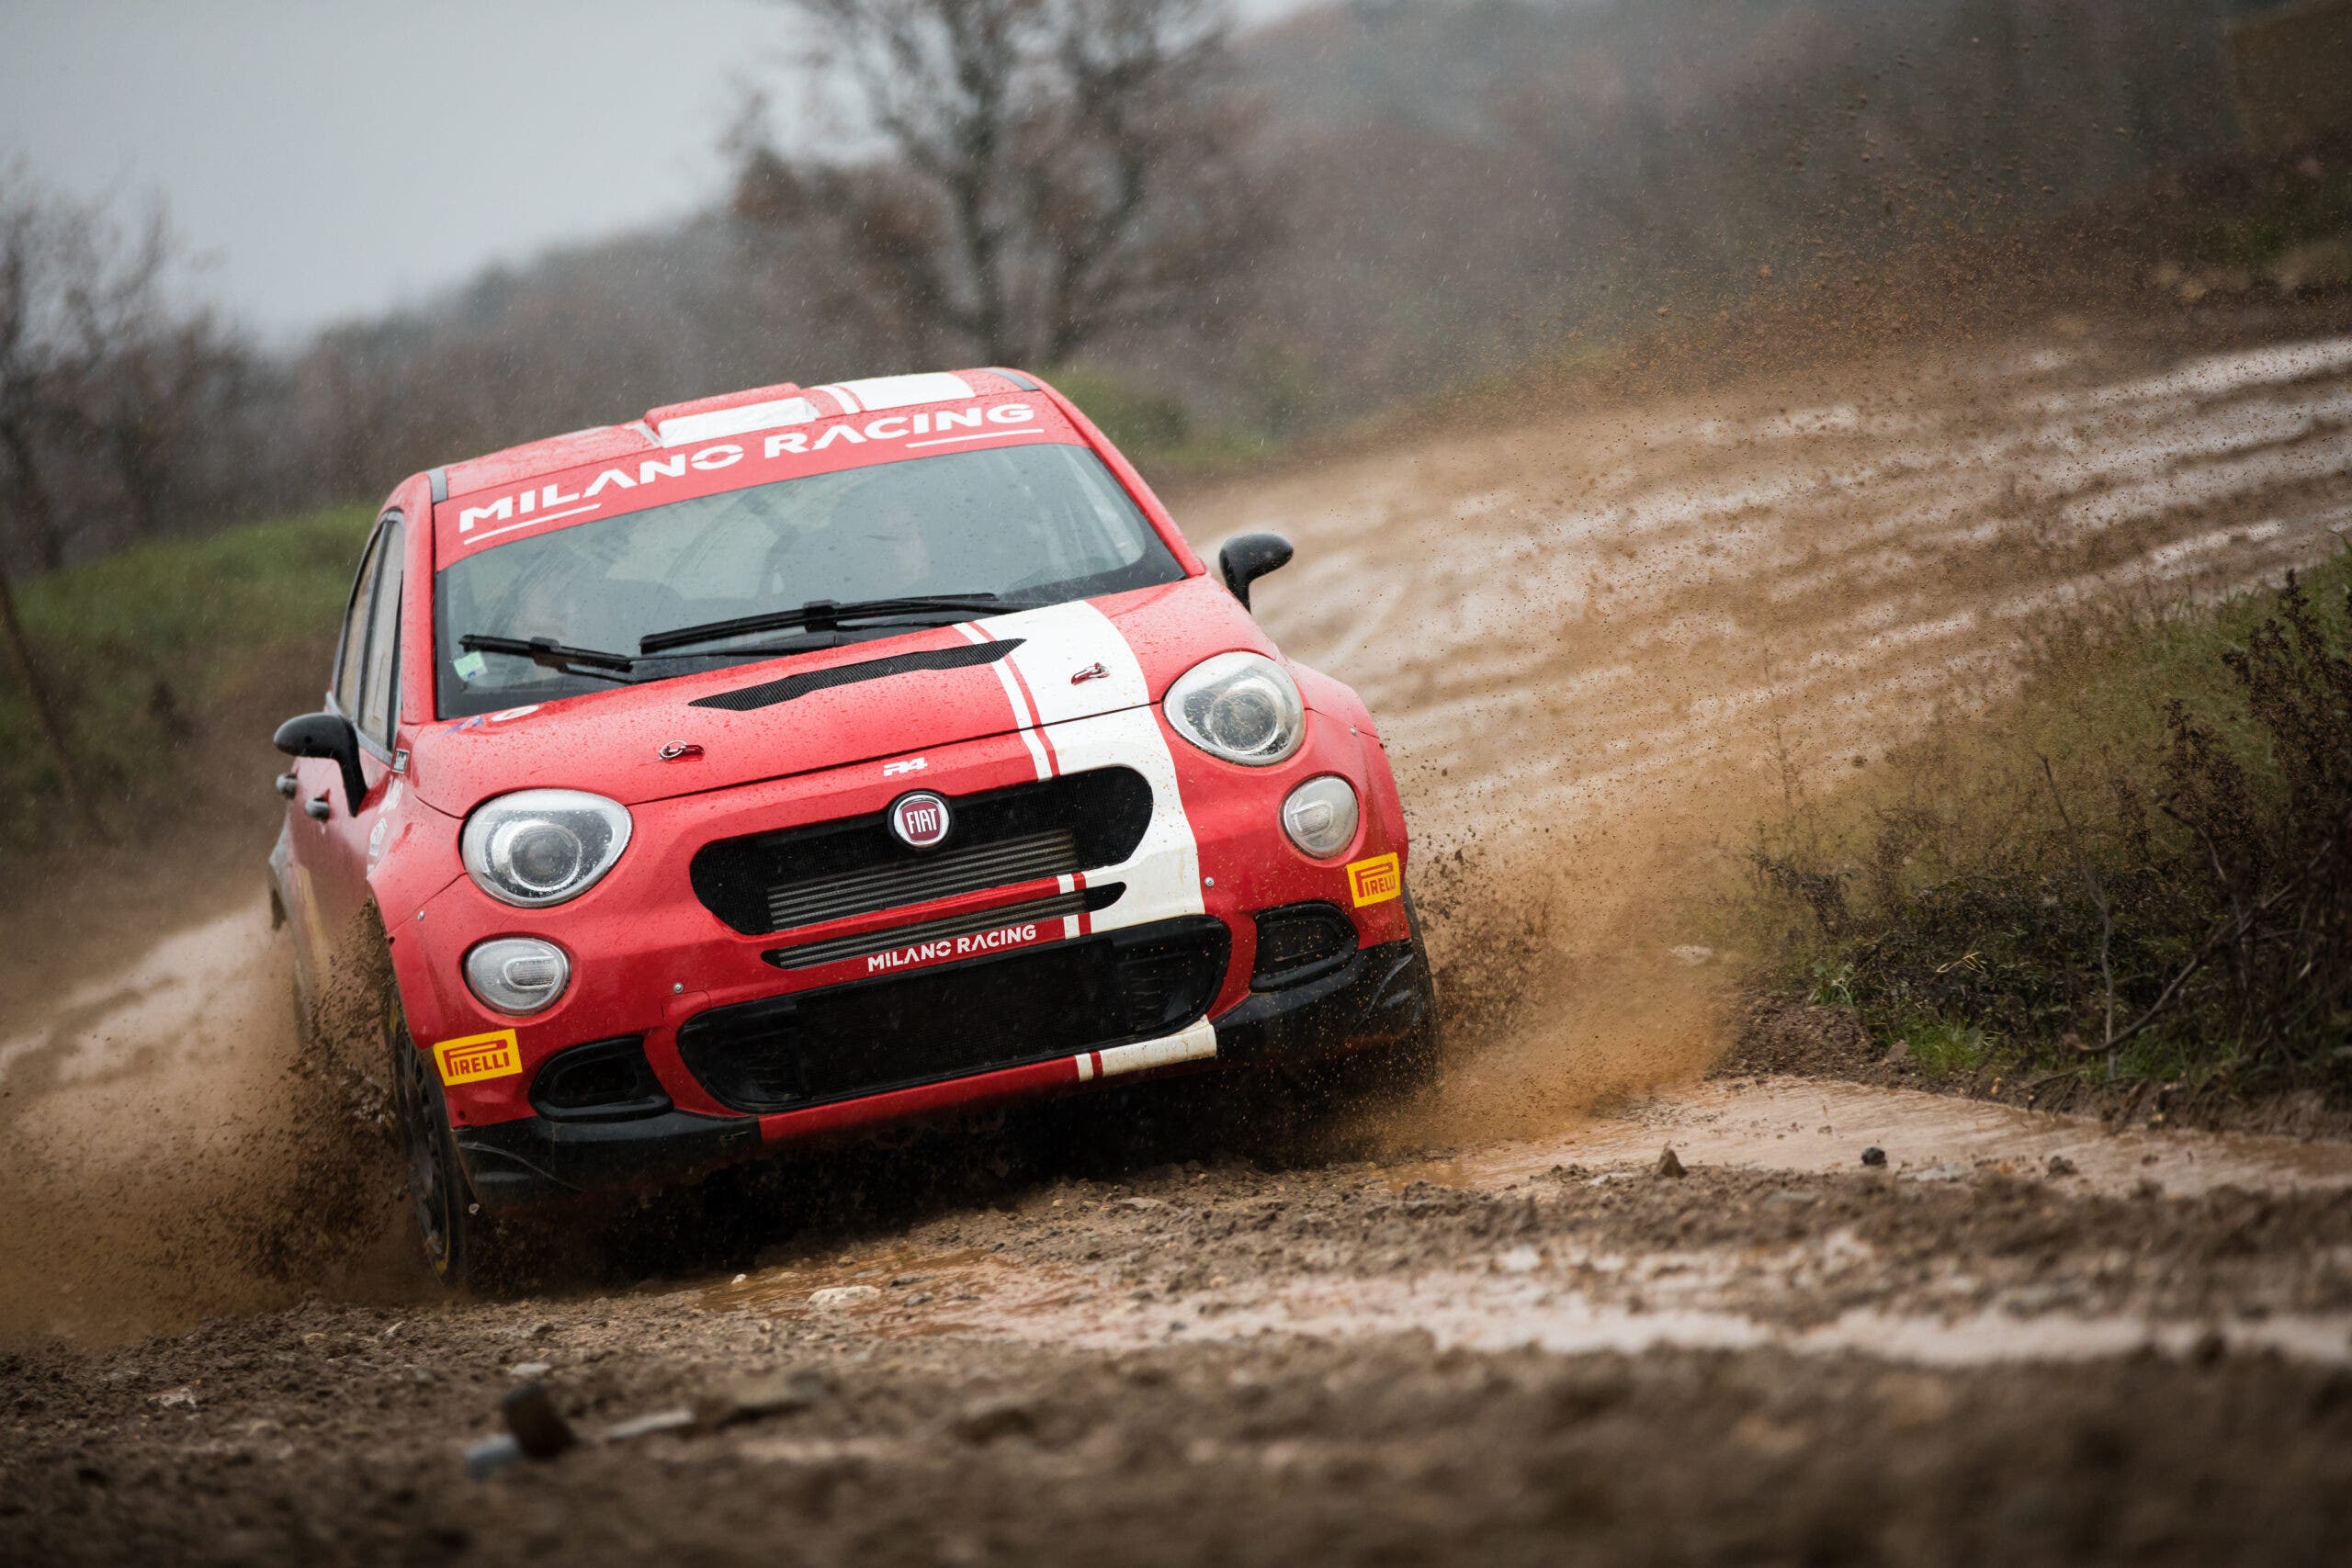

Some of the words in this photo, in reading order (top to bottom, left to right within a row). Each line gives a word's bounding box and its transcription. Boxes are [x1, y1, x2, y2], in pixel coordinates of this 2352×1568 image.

[459, 445, 743, 533] MILANO
[764, 403, 1035, 458] RACING
[906, 808, 937, 834] FIAT
[1354, 862, 1396, 898] PIRELLI
[867, 941, 952, 973] MILANO
[956, 924, 1036, 953] RACING
[443, 1039, 510, 1077] PIRELLI
